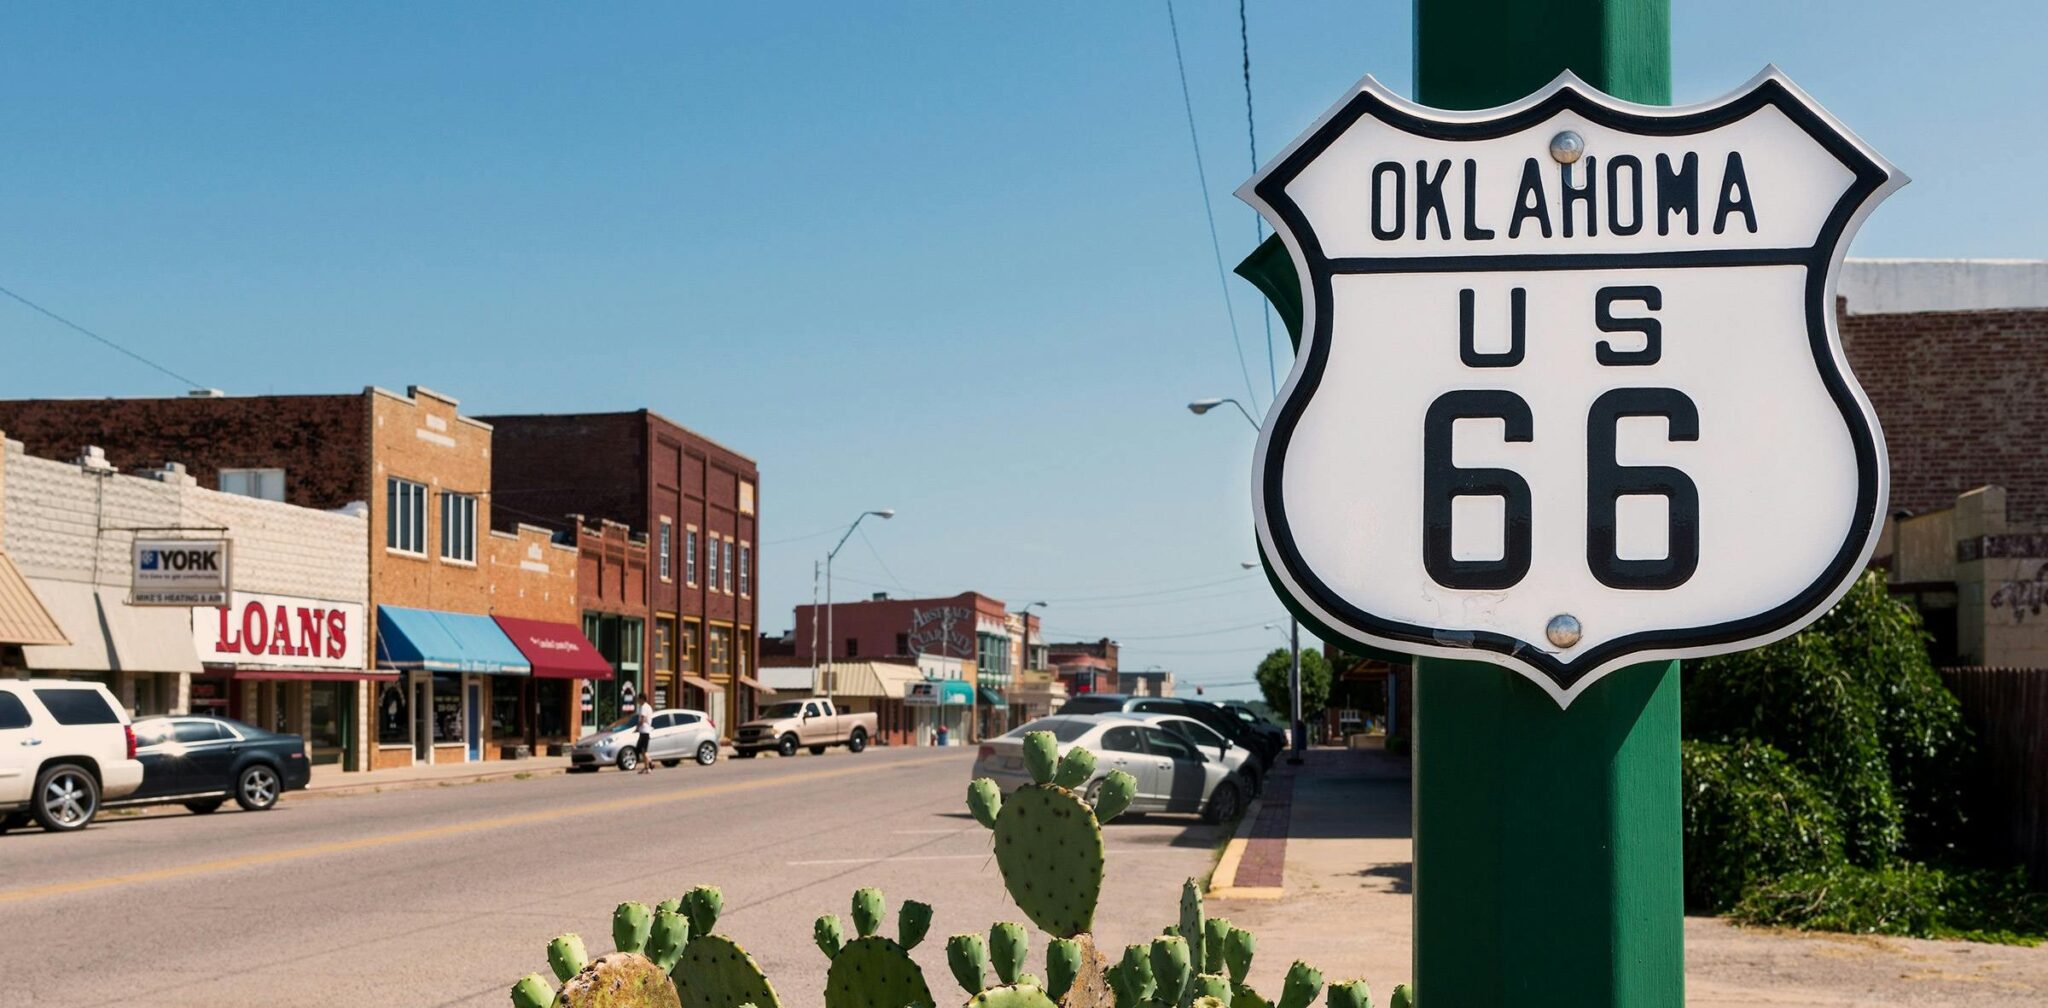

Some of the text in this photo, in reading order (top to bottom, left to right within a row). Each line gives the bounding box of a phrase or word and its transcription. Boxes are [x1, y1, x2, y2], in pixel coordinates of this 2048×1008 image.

[1371, 151, 1758, 241] OKLAHOMA
[1423, 387, 1700, 590] 66
[160, 550, 218, 570] YORK
[136, 594, 222, 603] MIKE'S HEATING & AIR
[216, 601, 346, 660] LOANS
